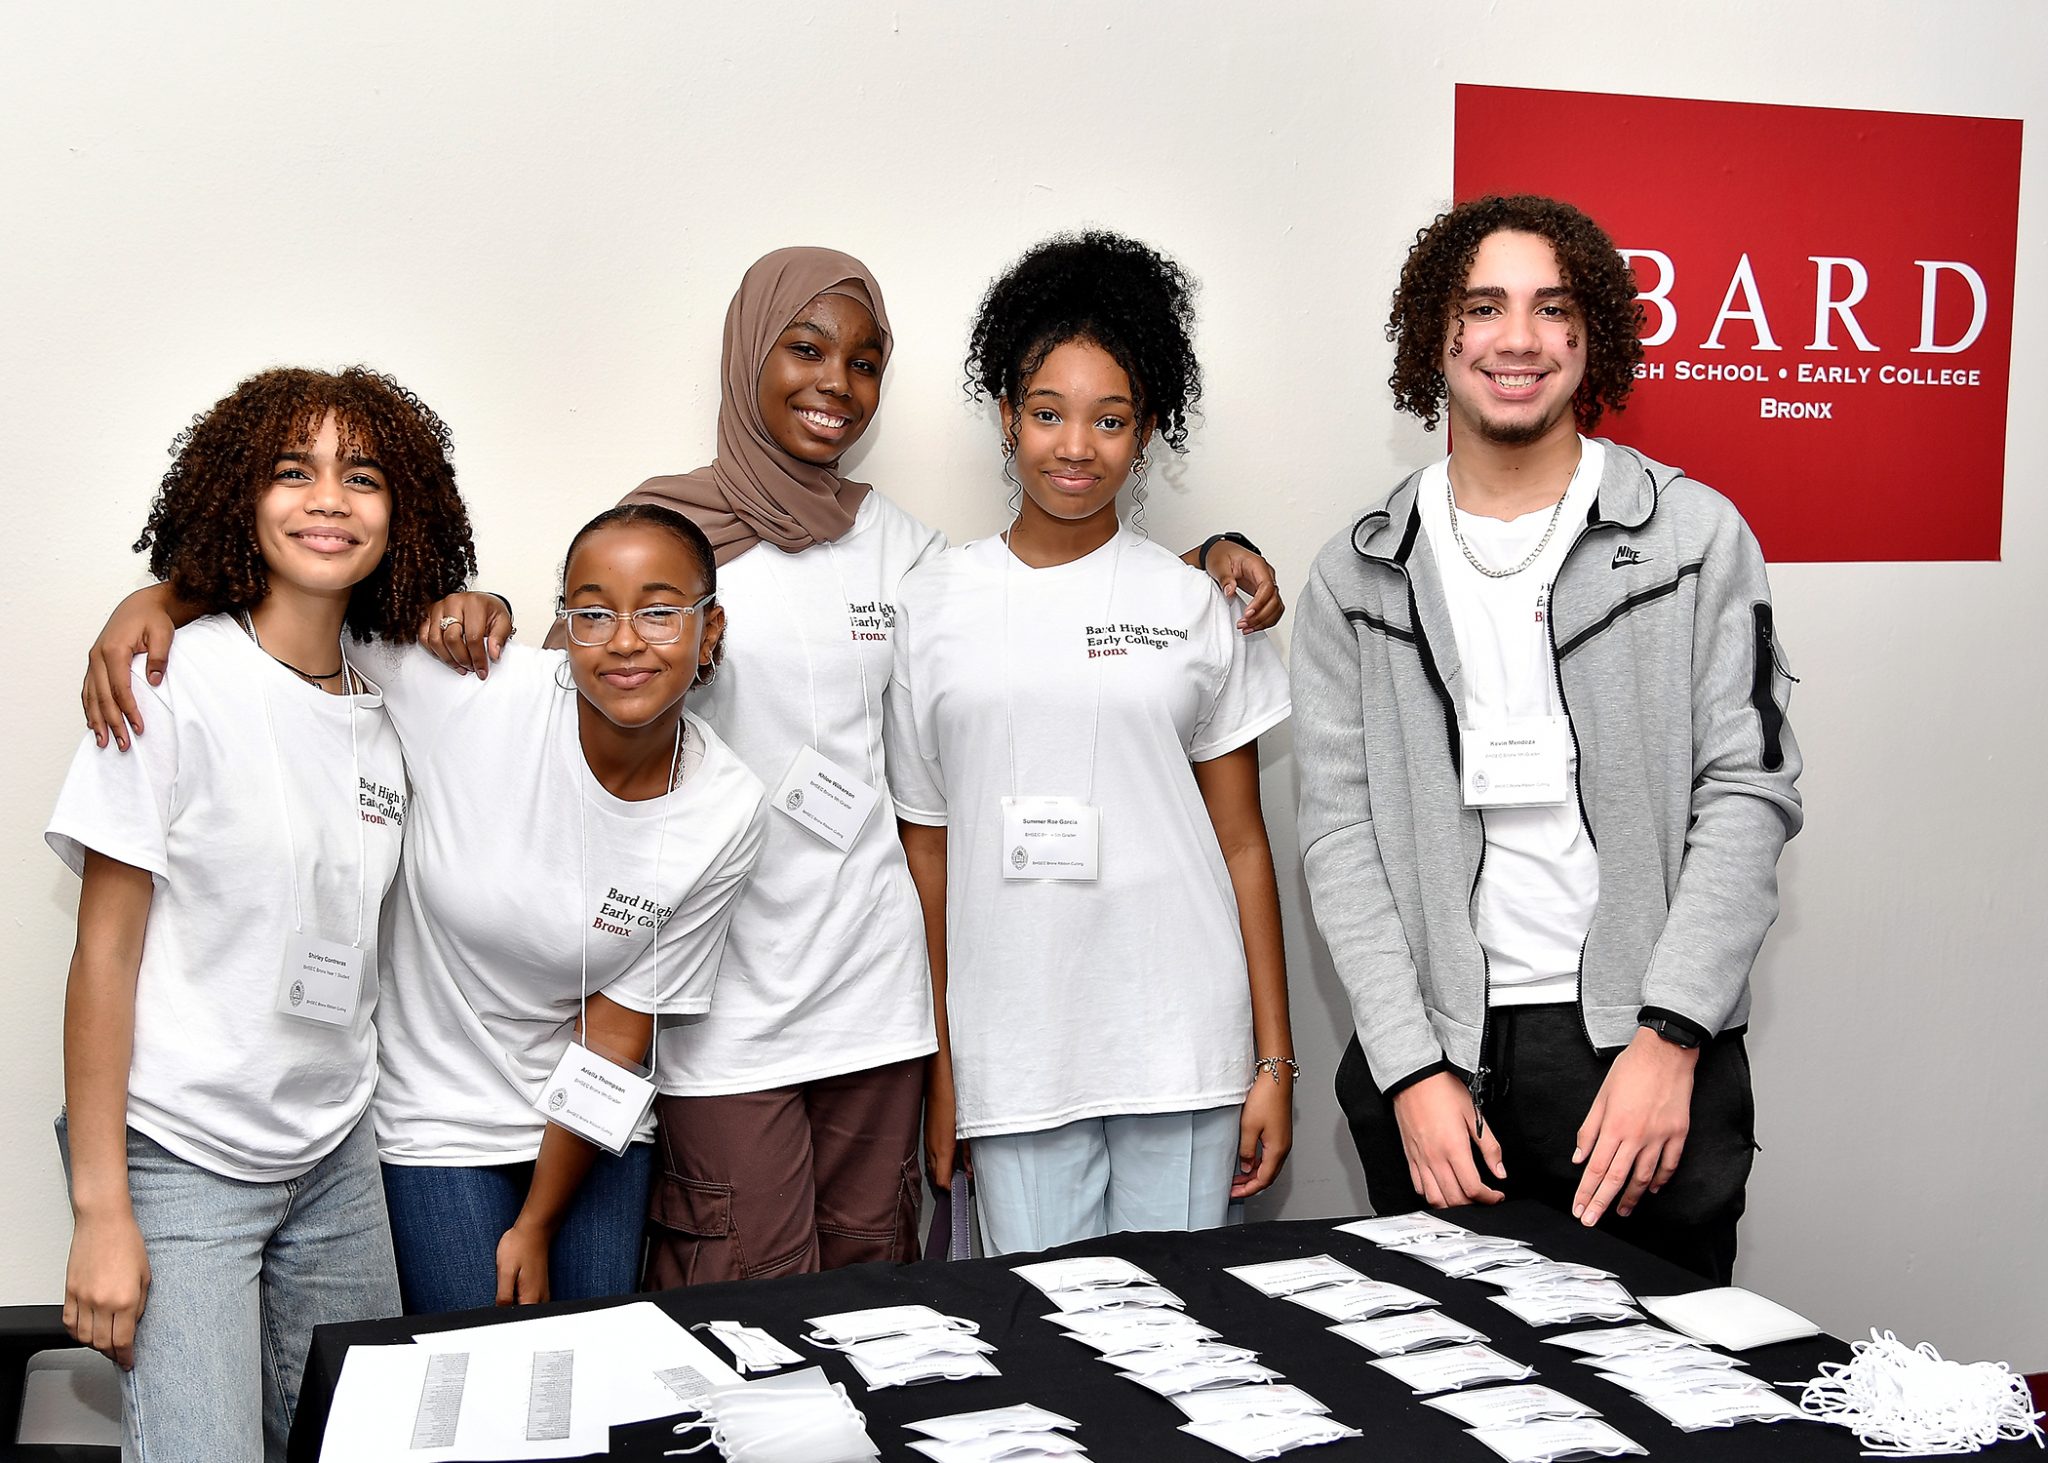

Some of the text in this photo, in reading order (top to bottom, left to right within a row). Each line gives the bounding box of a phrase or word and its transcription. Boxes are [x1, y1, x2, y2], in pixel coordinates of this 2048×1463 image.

[1615, 248, 1988, 354] BARD
[1633, 361, 1981, 386] GH SCHOOL EARLY COLLEGE
[1759, 397, 1833, 420] BRONX
[1615, 545, 1641, 561] NIKE
[1087, 635, 1169, 650] Early College
[1119, 624, 1149, 636] High
[1152, 627, 1189, 641] School
[1088, 647, 1128, 659] Bronx
[377, 785, 400, 805] High
[378, 803, 403, 826] Colleg
[600, 902, 635, 925] Early
[606, 887, 673, 918] Bard High
[592, 916, 632, 937] Bronx
[580, 1066, 626, 1094] Ariella Thompson
